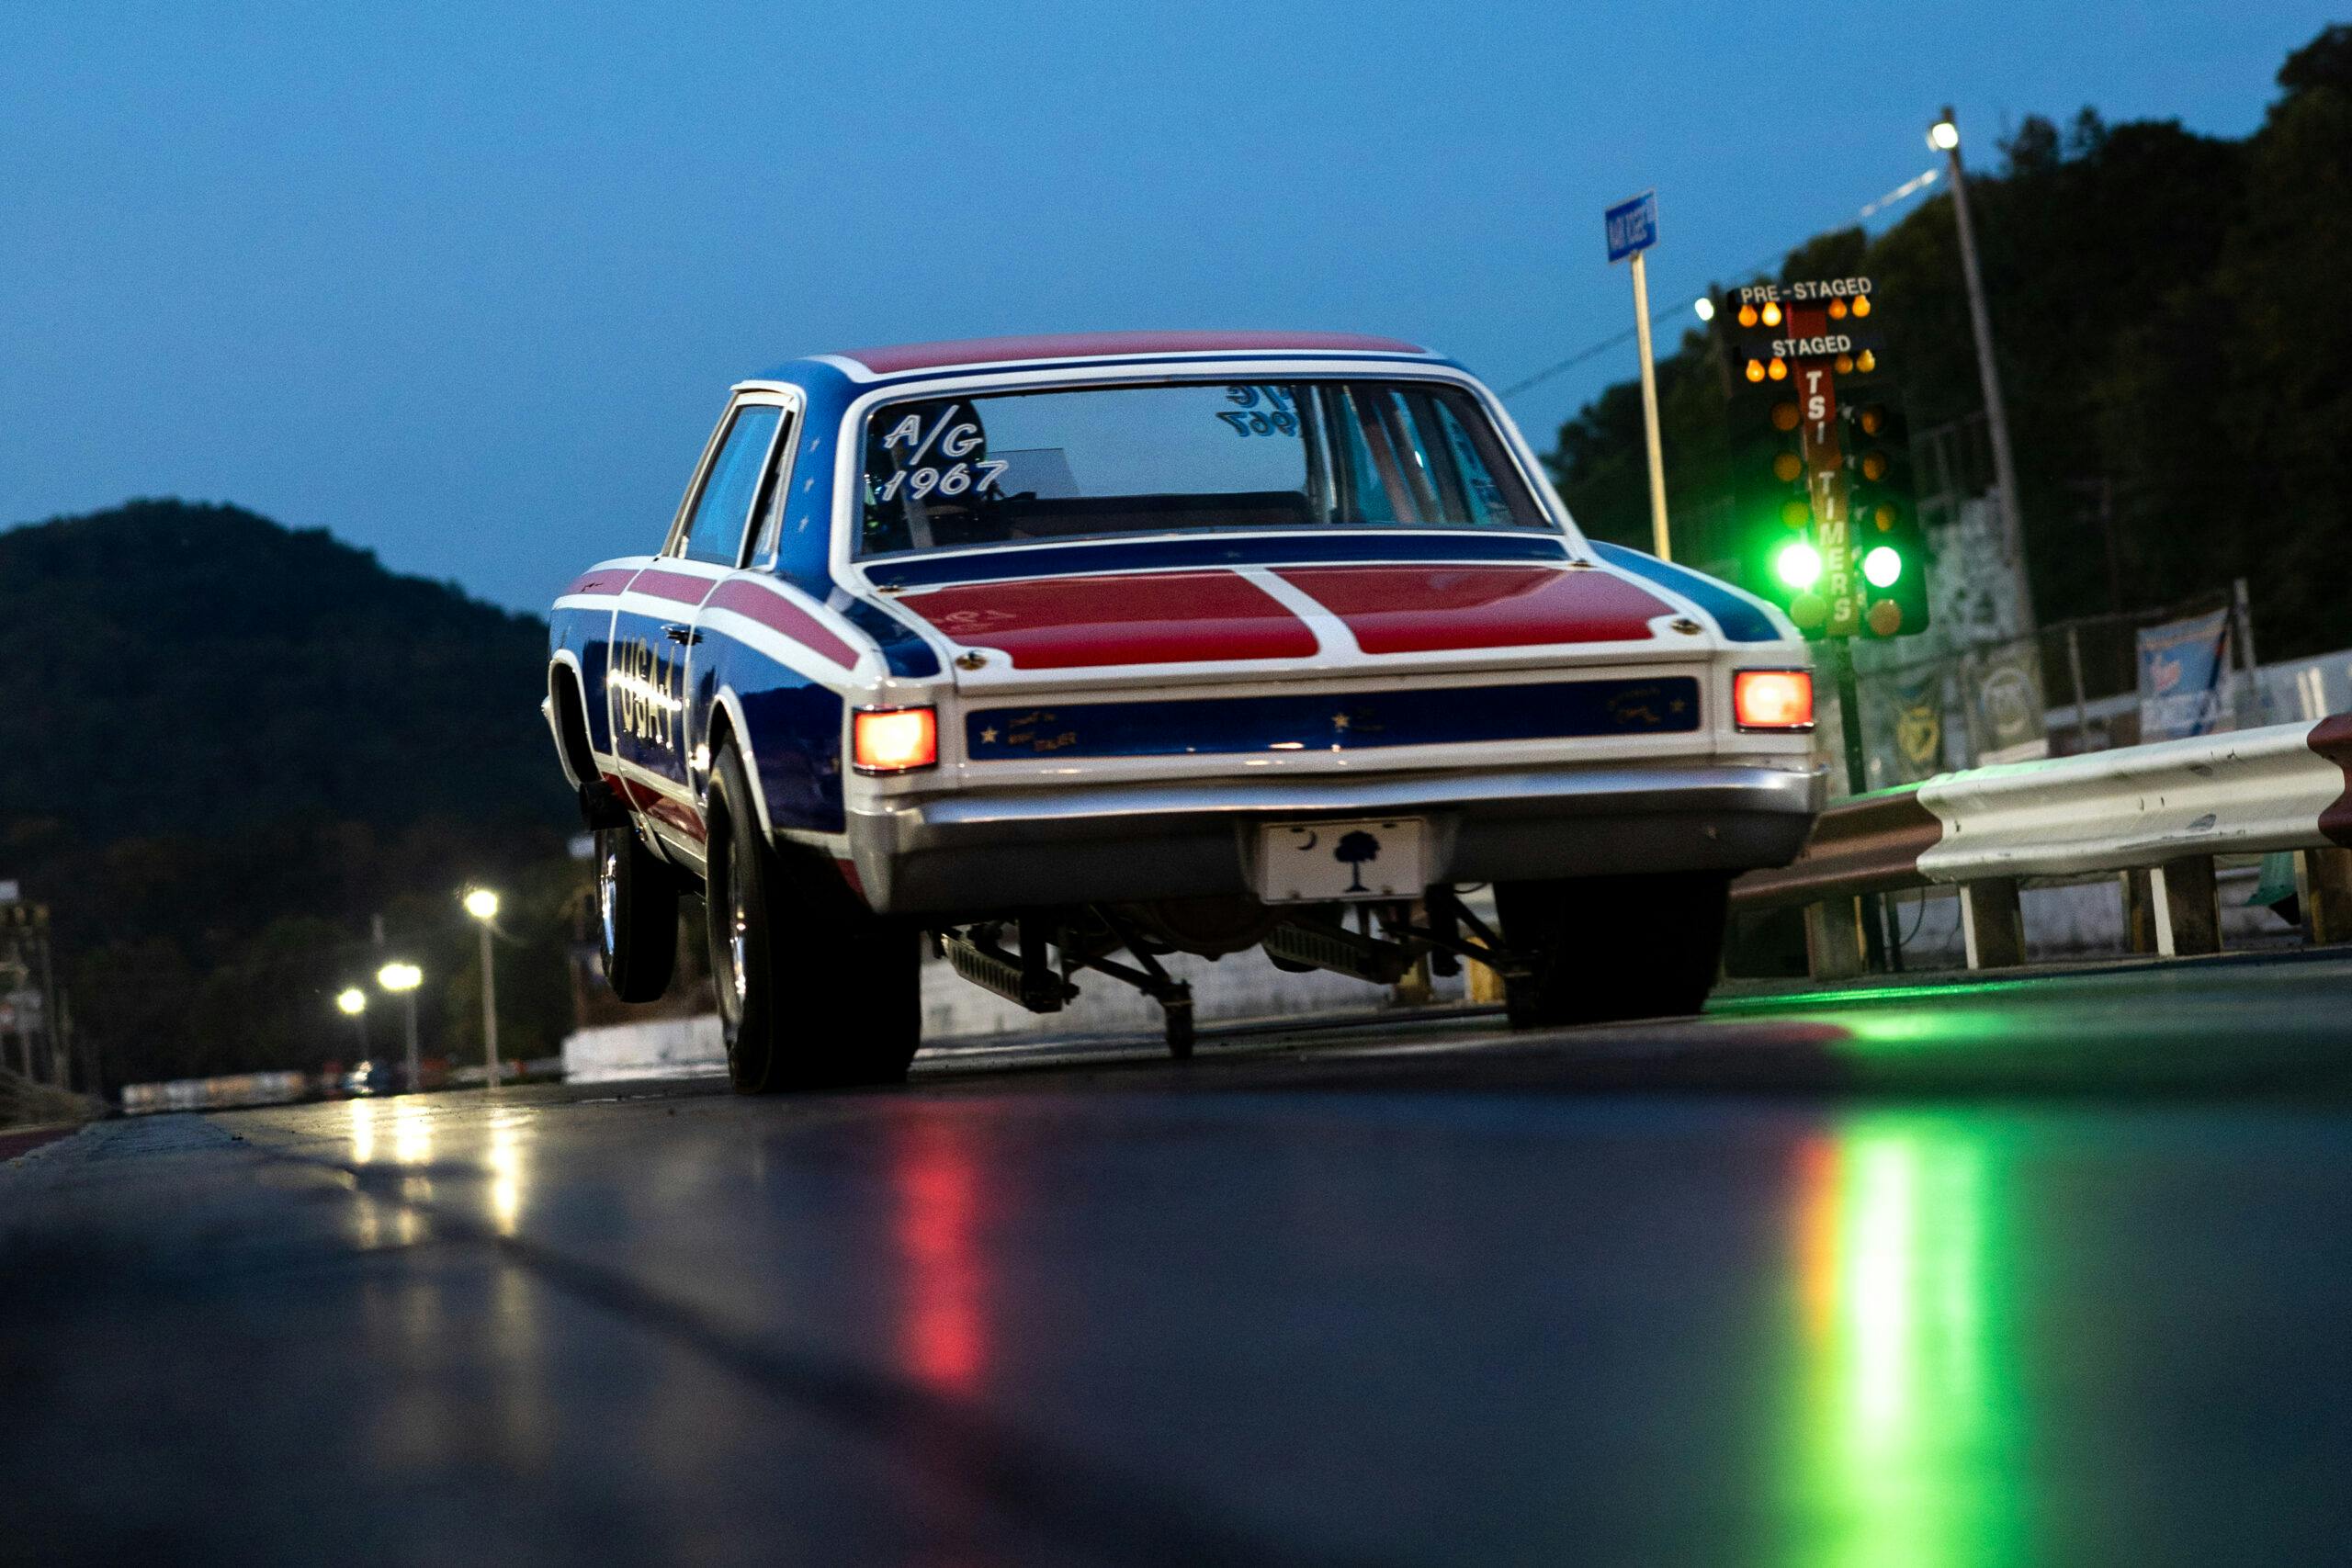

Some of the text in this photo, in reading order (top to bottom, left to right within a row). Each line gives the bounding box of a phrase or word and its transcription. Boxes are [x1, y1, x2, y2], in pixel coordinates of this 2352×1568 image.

[1740, 276, 1872, 304] PRE-STAGED
[1771, 334, 1851, 358] STAGED
[883, 404, 983, 466] A/G
[883, 459, 1009, 502] 1967
[1805, 370, 1852, 623] TSI TIMERS
